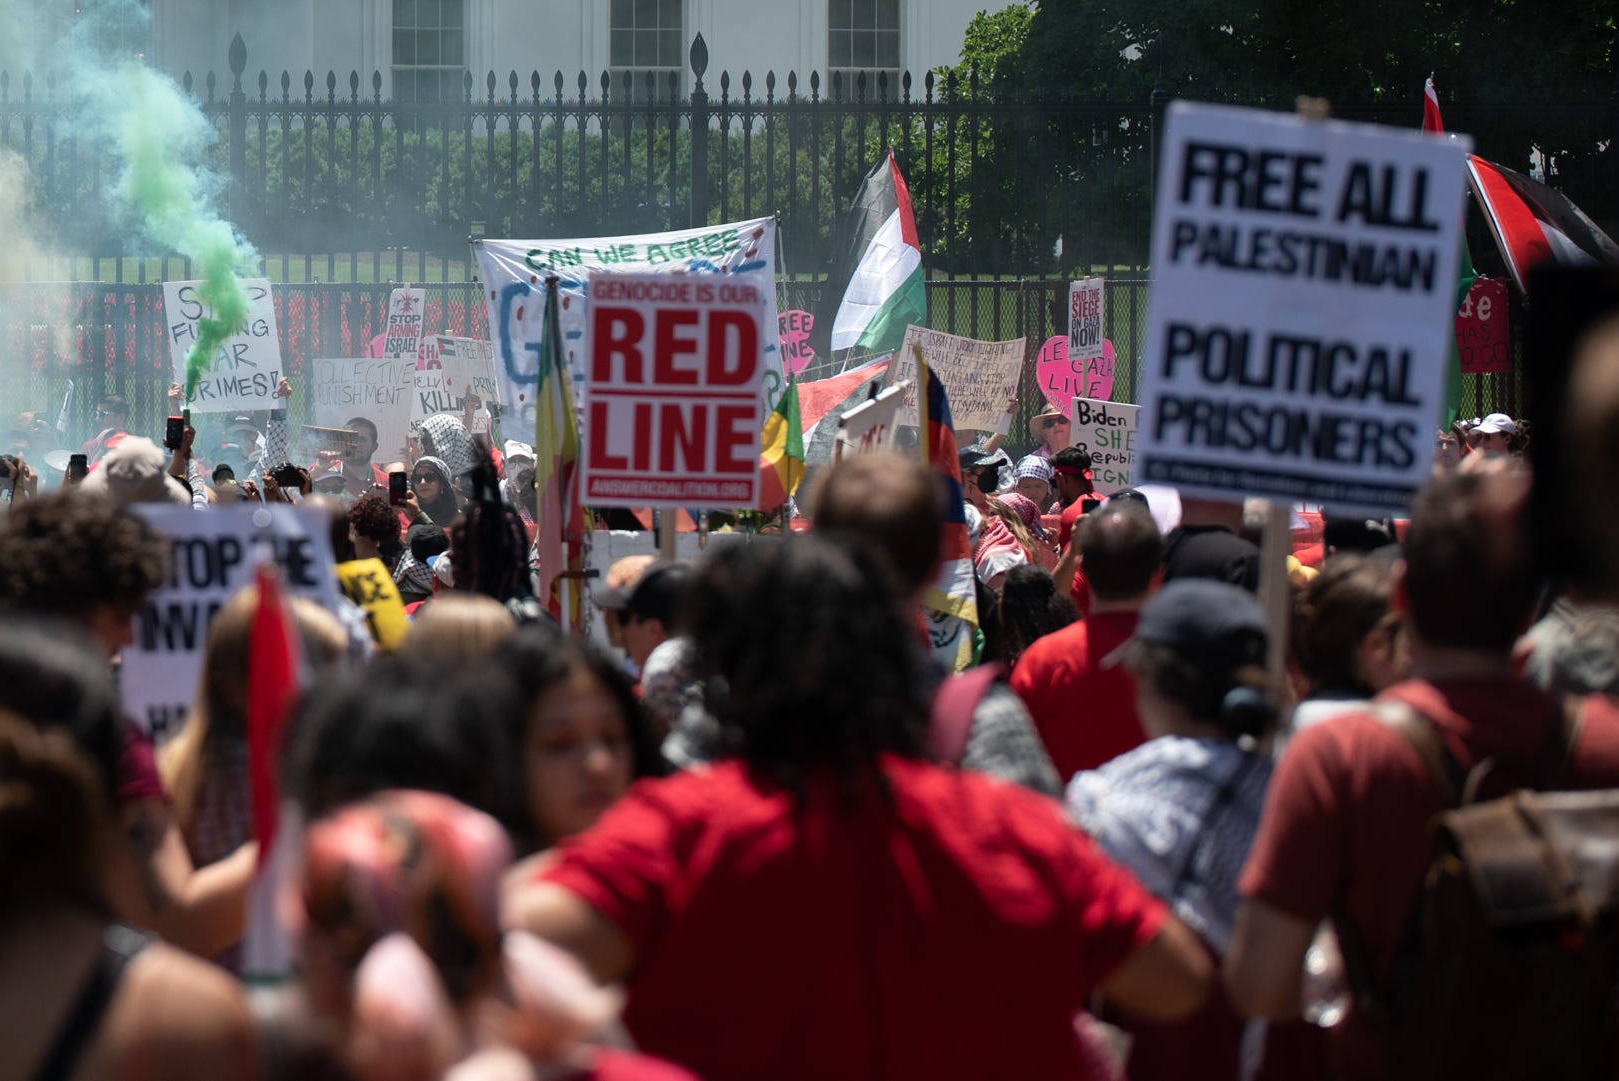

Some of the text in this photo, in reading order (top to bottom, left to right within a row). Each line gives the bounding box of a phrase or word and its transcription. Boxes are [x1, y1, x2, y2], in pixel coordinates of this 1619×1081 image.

[1178, 141, 1441, 233] FREE ALL
[525, 228, 742, 271] CAN WE AGREE
[1169, 221, 1437, 294] PALESTINIAN
[593, 280, 759, 305] GENOCIDE IS OUR
[1072, 288, 1100, 302] END THE
[389, 314, 421, 324] STOP
[1071, 300, 1100, 319] SIEGE
[387, 323, 421, 337] ARMING
[778, 313, 814, 335] REE
[1071, 317, 1101, 329] ON GAZA
[385, 337, 418, 353] ISRAEL
[592, 307, 758, 386] RED
[1070, 327, 1100, 348] NOW!
[1043, 341, 1068, 363] LE
[1163, 321, 1423, 409] POLITICAL
[1077, 400, 1127, 427] Biden
[588, 401, 756, 474] LINE
[1152, 395, 1418, 470] PRISONERS
[170, 536, 242, 589] TOP
